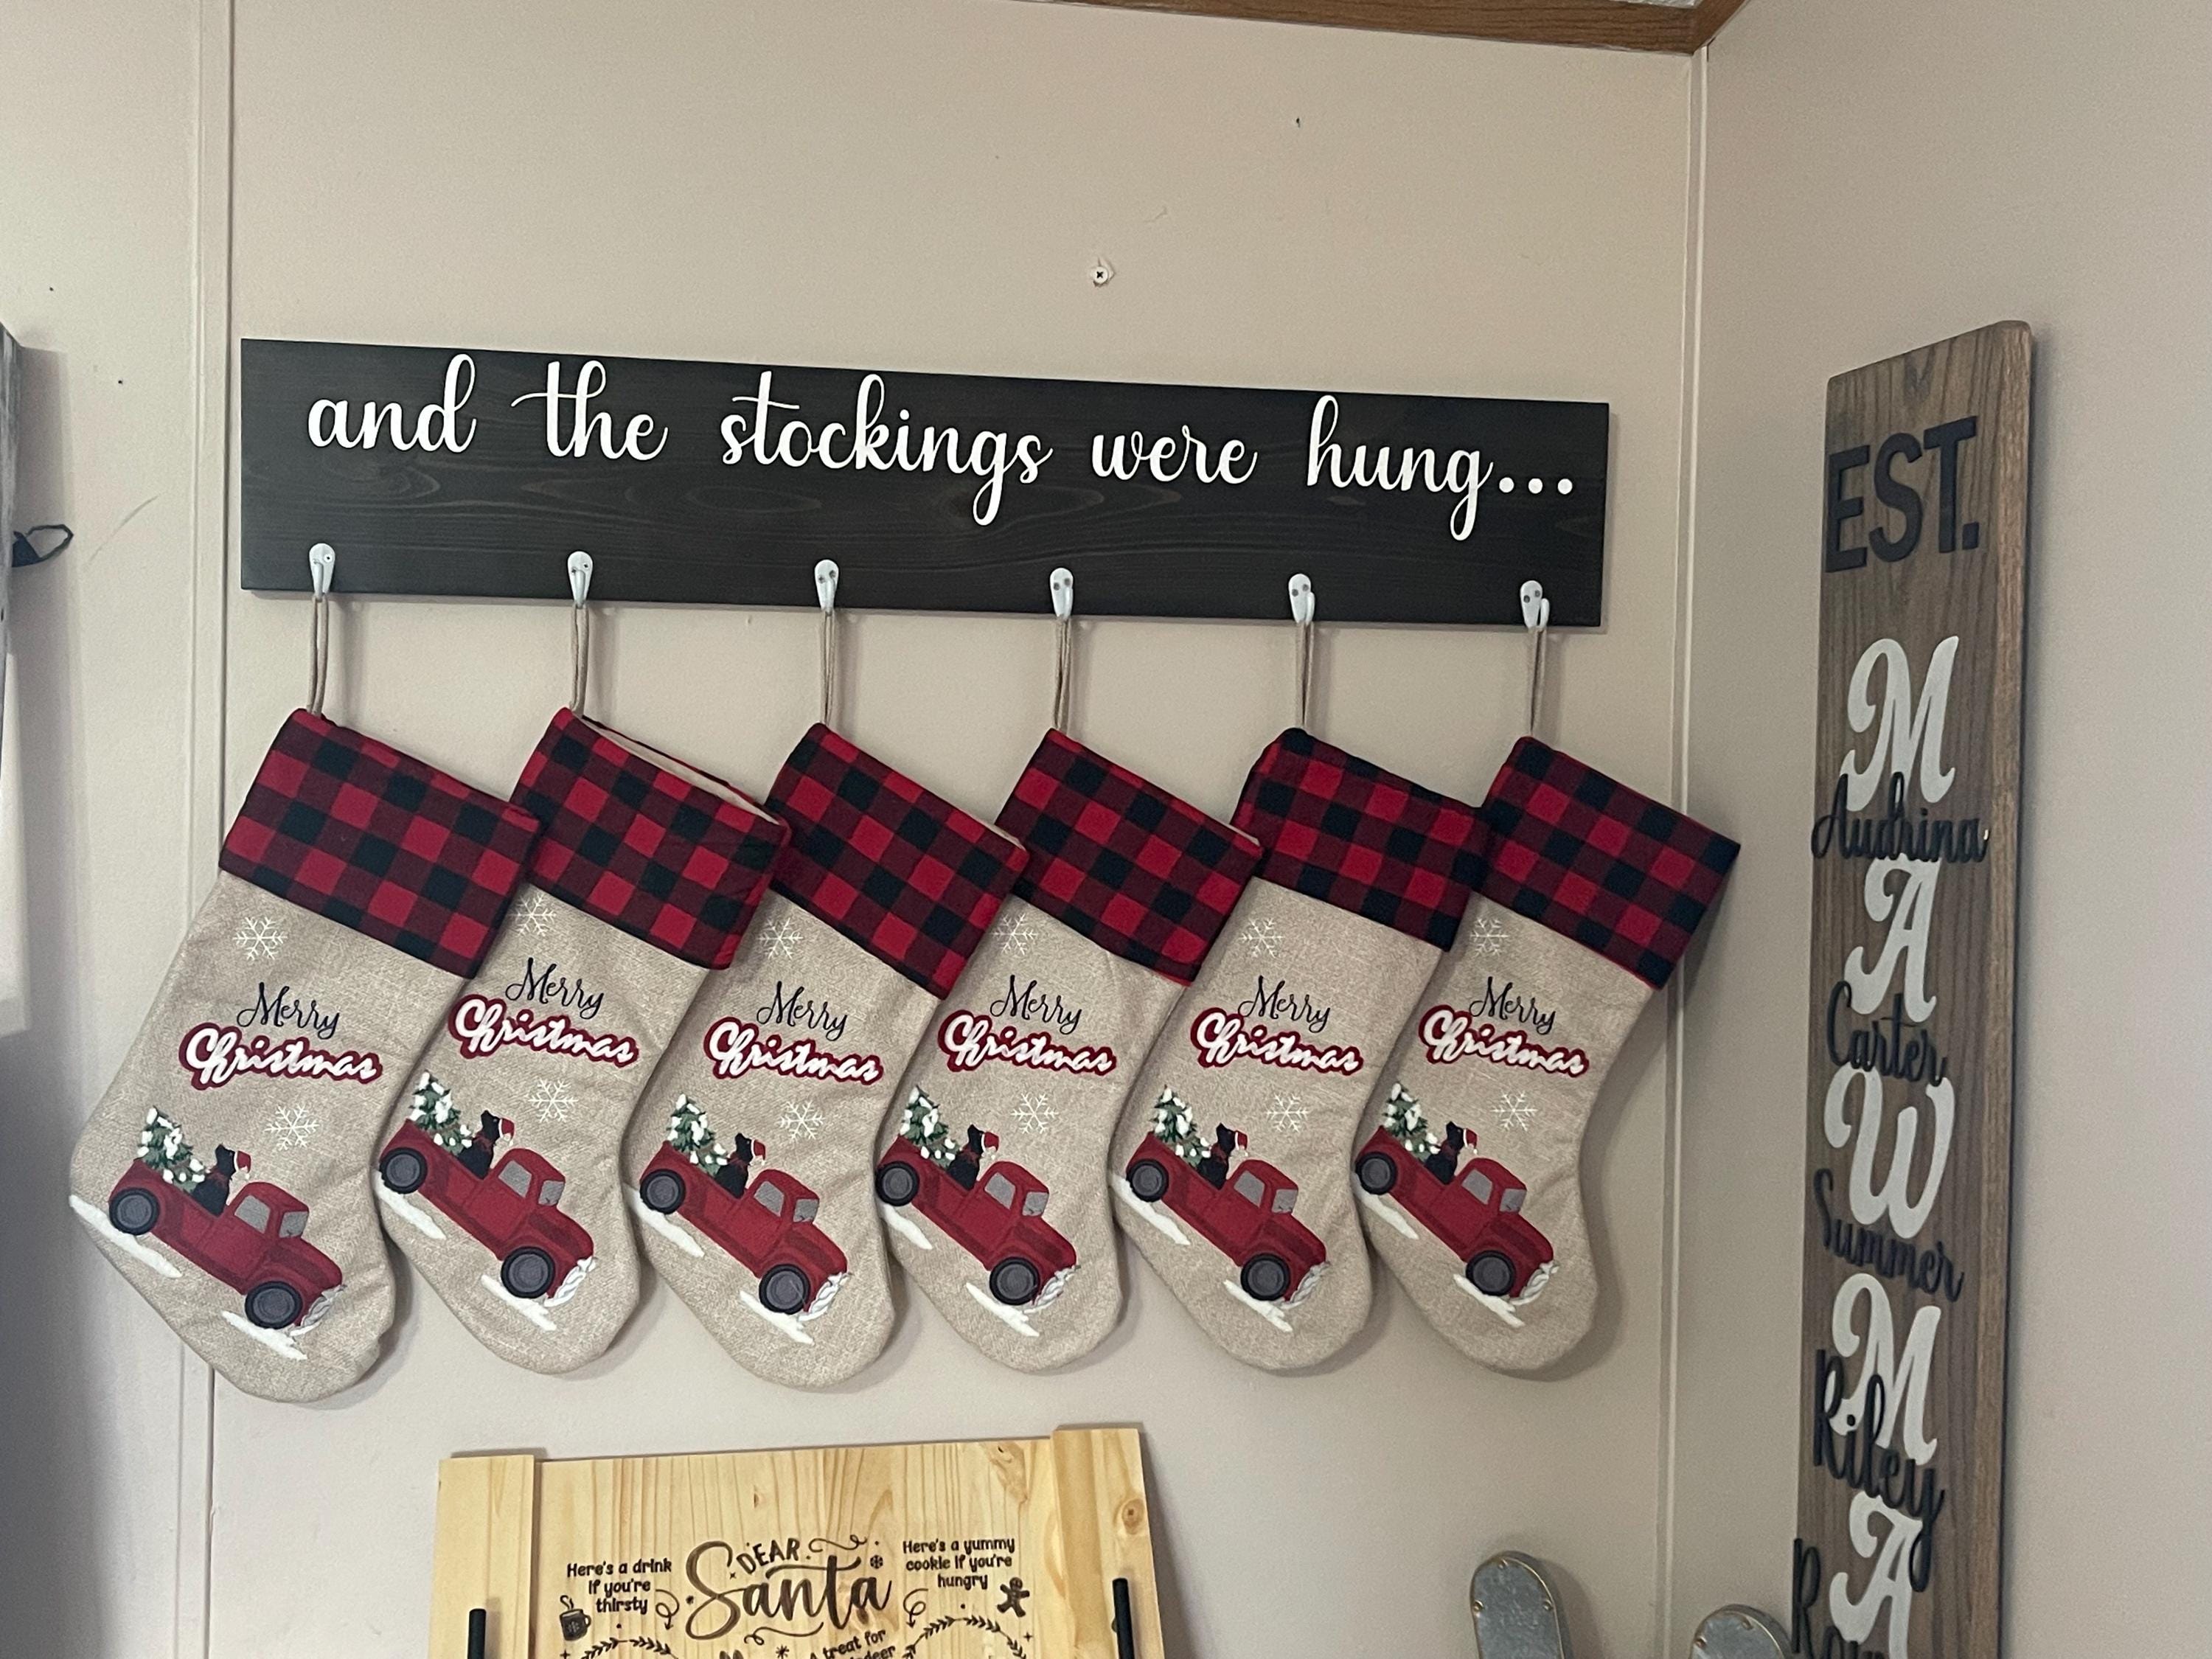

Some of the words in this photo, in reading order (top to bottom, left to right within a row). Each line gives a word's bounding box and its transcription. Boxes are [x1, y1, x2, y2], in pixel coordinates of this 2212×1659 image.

[307, 353, 477, 453] and
[511, 359, 668, 462] the
[720, 370, 1053, 526] stockings
[1091, 425, 1257, 484] were
[1307, 394, 1573, 541] hung...
[1824, 415, 1980, 573] EST.
[1811, 771, 1990, 863] Audrina
[236, 981, 341, 1040] Merry
[504, 957, 605, 1020] Merry
[757, 980, 849, 1042] Merry
[990, 974, 1082, 1035] Merry
[1238, 975, 1331, 1034] Merry
[1469, 975, 1558, 1035] Merry
[179, 1023, 383, 1091] Christmas
[449, 993, 640, 1068] Christmas
[703, 1016, 884, 1085] Christmas
[938, 1009, 1118, 1076] Christmas
[1190, 1007, 1364, 1076] Christmas
[1419, 1004, 1590, 1077] Christmas
[1826, 980, 1948, 1087] Carter
[1812, 1169, 1965, 1302] Summer
[1812, 1349, 1946, 1593] Riley
[567, 1561, 613, 1578] Here's
[619, 1562, 628, 1574] a
[633, 1557, 672, 1573] drink
[902, 1538, 945, 1554] Here's
[951, 1540, 959, 1551] a
[964, 1538, 1015, 1555] yummy
[905, 1555, 950, 1571] cookie
[955, 1554, 966, 1569] if
[969, 1554, 1012, 1573] you're
[588, 1579, 601, 1595] if
[604, 1578, 651, 1598] you're
[596, 1596, 648, 1615] thirsty
[686, 1540, 892, 1641] Santa
[937, 1573, 988, 1590] hungry
[823, 1636, 862, 1659] treat
[865, 1630, 886, 1646] for
